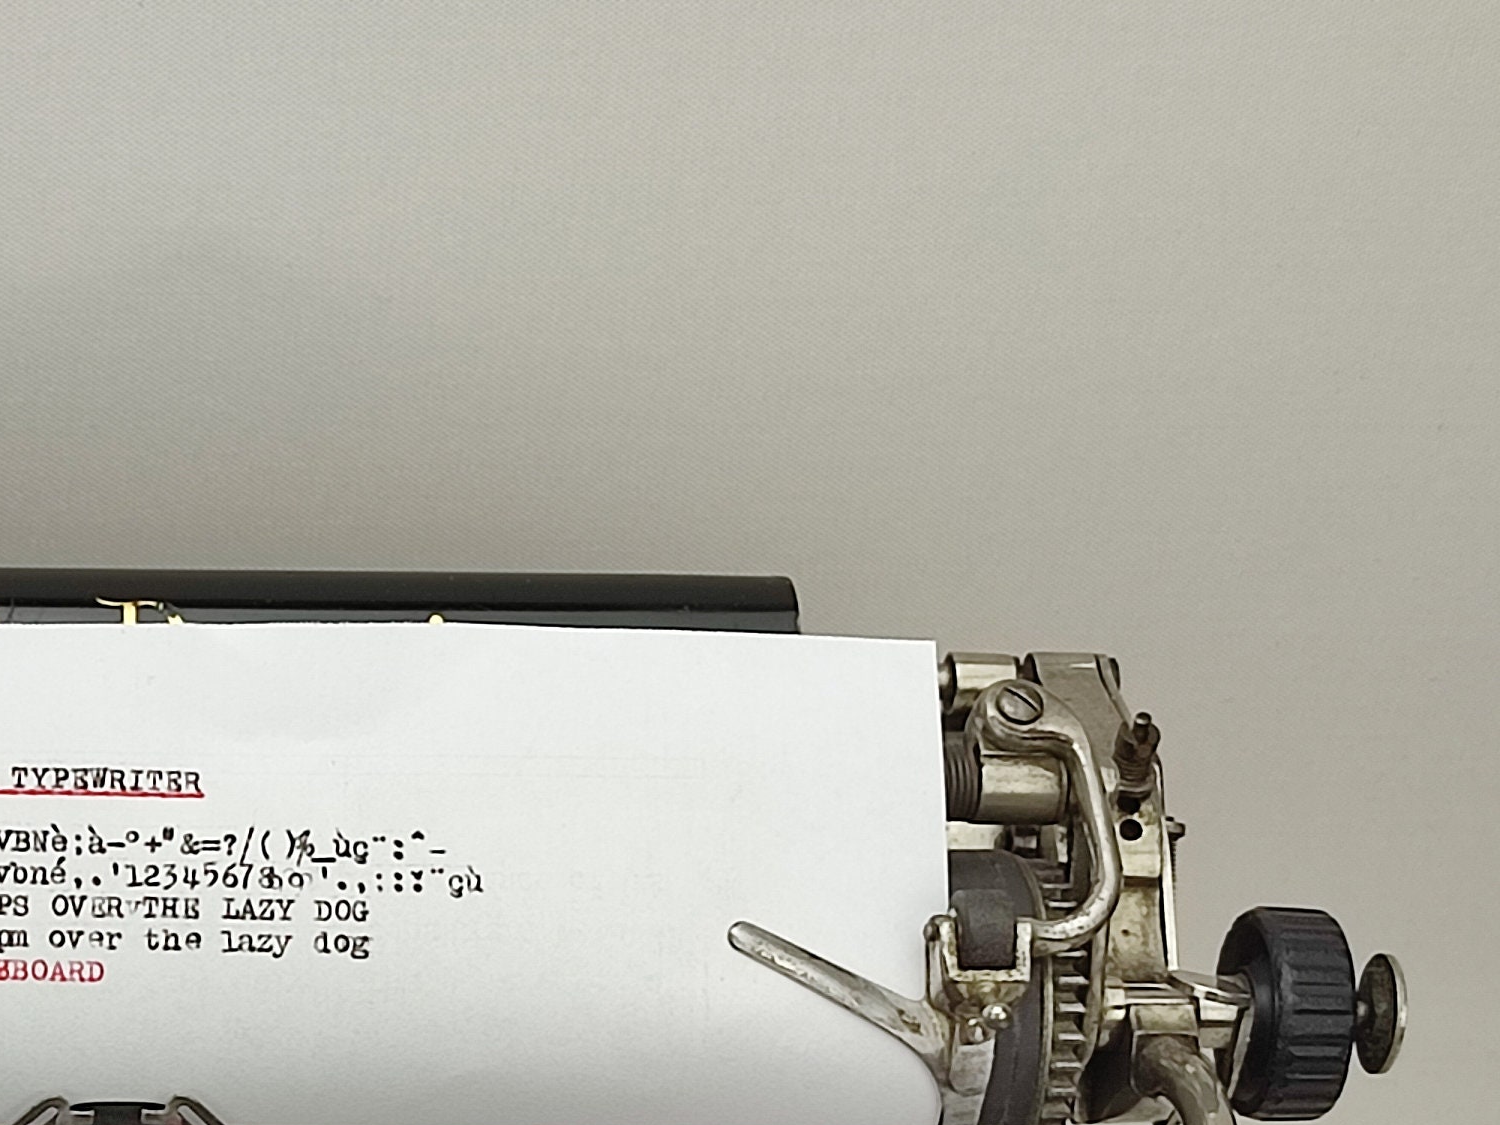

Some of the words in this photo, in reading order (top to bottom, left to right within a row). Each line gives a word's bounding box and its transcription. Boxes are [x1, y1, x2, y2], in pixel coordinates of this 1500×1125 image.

[10, 767, 201, 790] TYPEWRITER
[222, 897, 295, 921] LAZY
[314, 900, 369, 922] DOG
[145, 928, 201, 951] the
[221, 930, 293, 958] lazy
[314, 931, 372, 959] dog
